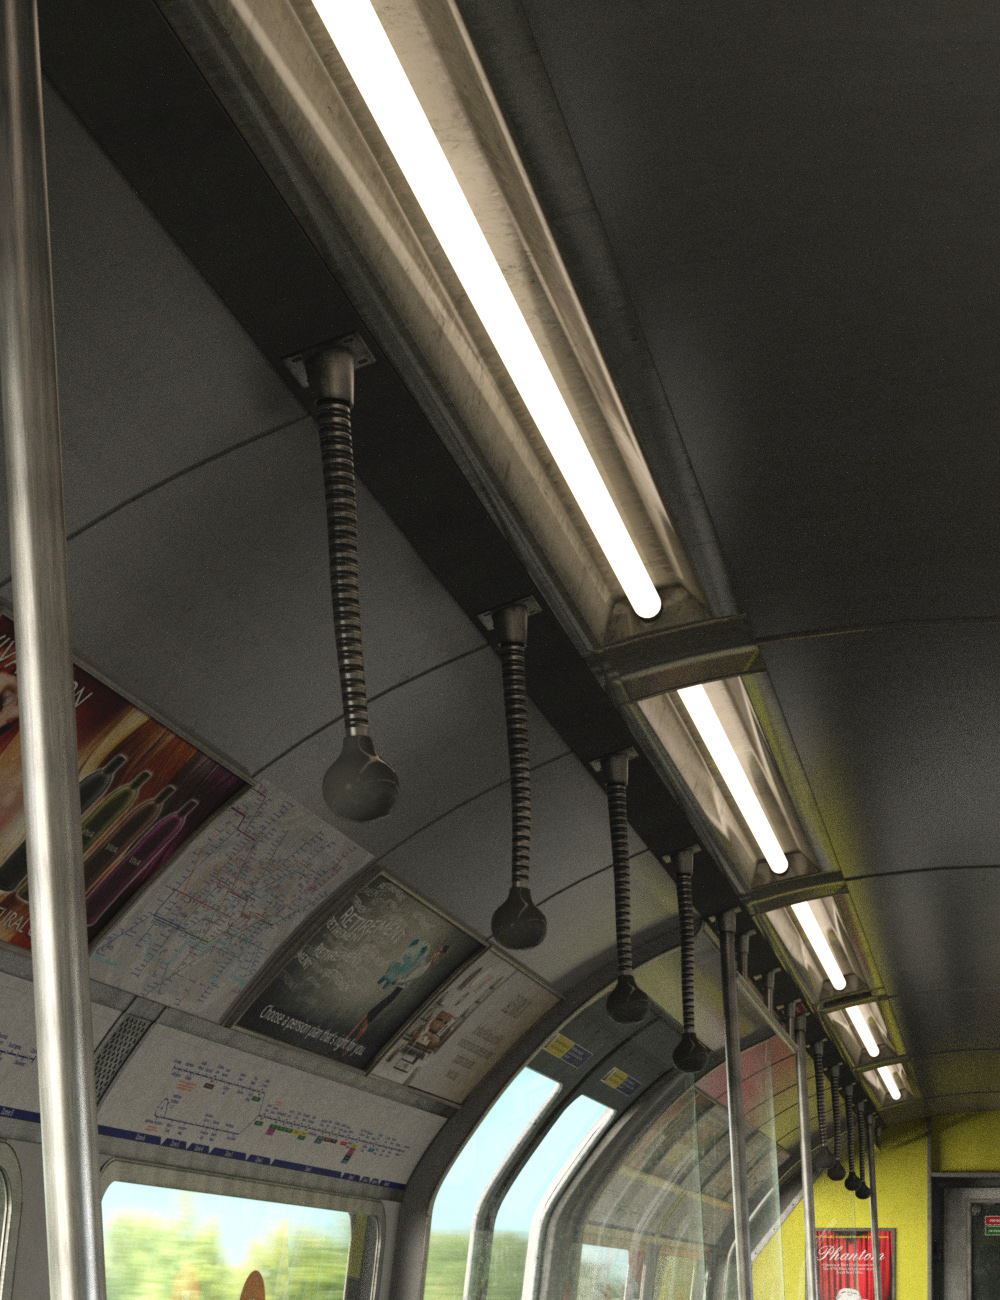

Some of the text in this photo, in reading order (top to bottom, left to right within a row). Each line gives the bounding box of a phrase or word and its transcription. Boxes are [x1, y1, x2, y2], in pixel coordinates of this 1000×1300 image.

[341, 905, 406, 943] RETIREMENT
[260, 1004, 287, 1025] Choose
[283, 1018, 312, 1035] pension
[305, 1024, 324, 1039] plan
